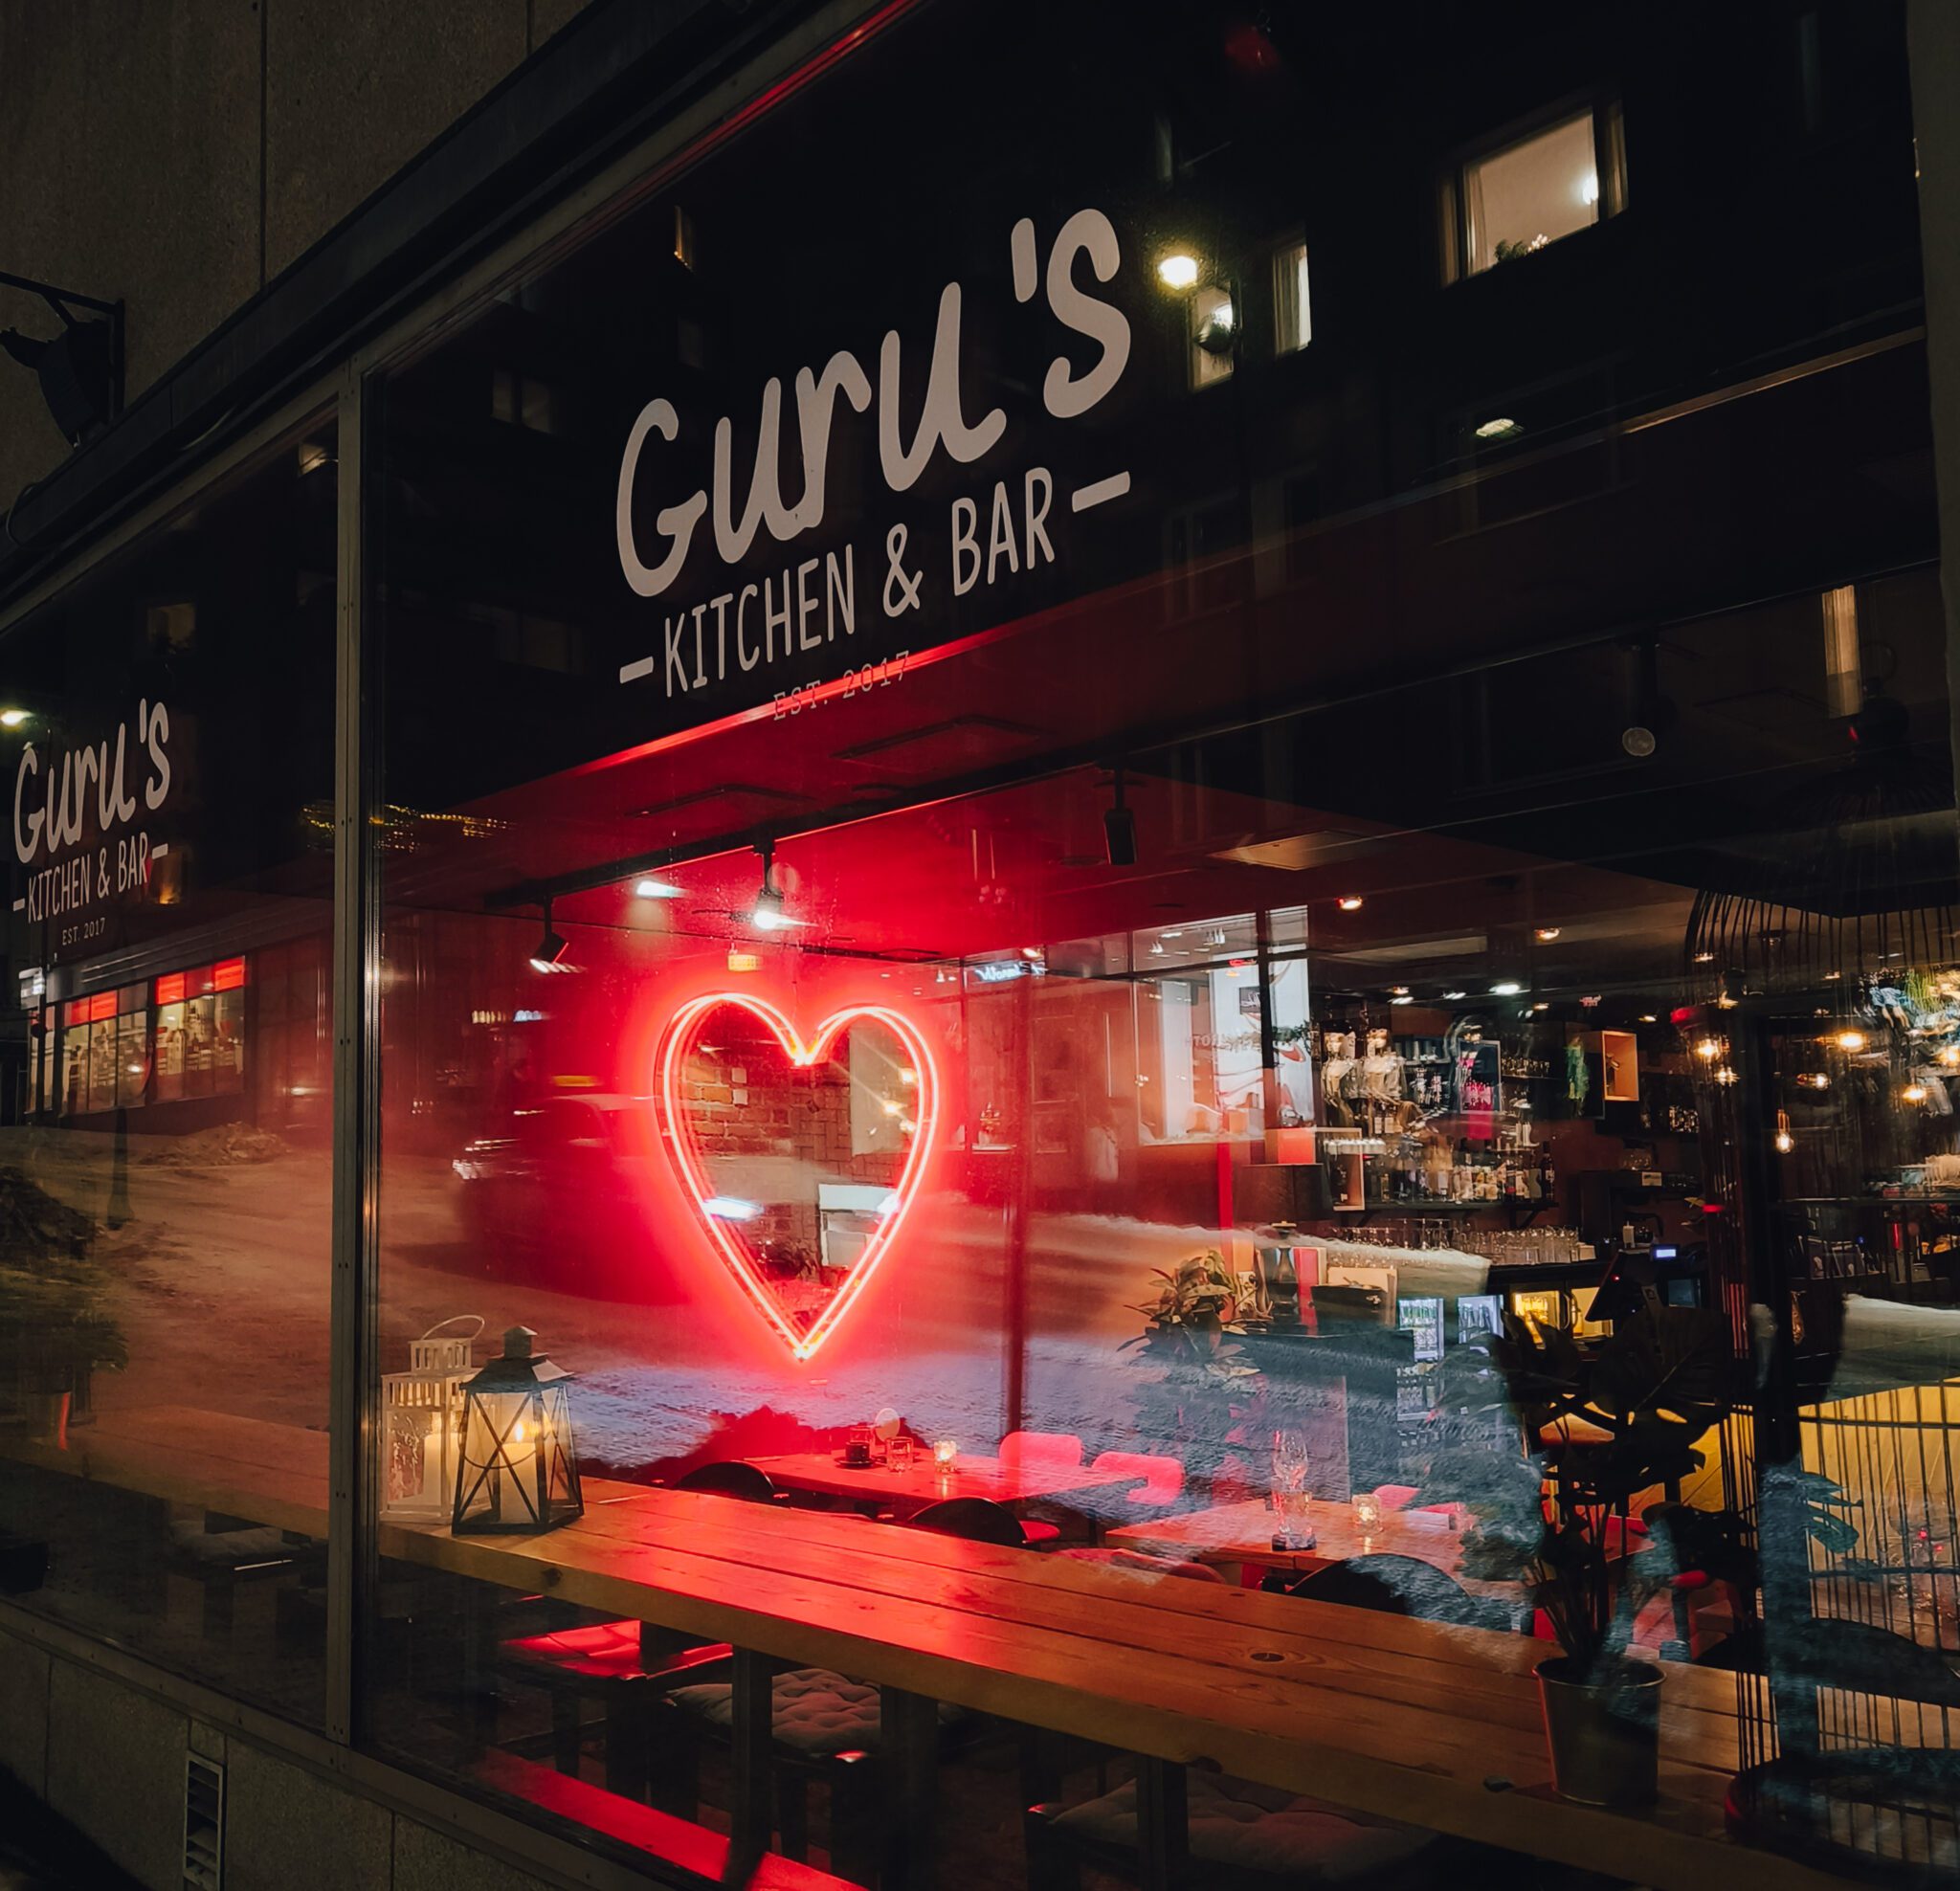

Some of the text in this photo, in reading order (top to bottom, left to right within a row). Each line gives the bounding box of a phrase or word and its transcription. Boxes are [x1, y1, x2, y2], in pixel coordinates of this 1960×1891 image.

[616, 209, 1131, 597] Guru's
[664, 467, 1055, 697] KITCHEN & BAR
[773, 650, 909, 721] EST. 2017
[14, 698, 170, 863] Guru's
[28, 832, 147, 923] KITCHEN & BAR
[62, 917, 105, 946] EST. 2017
